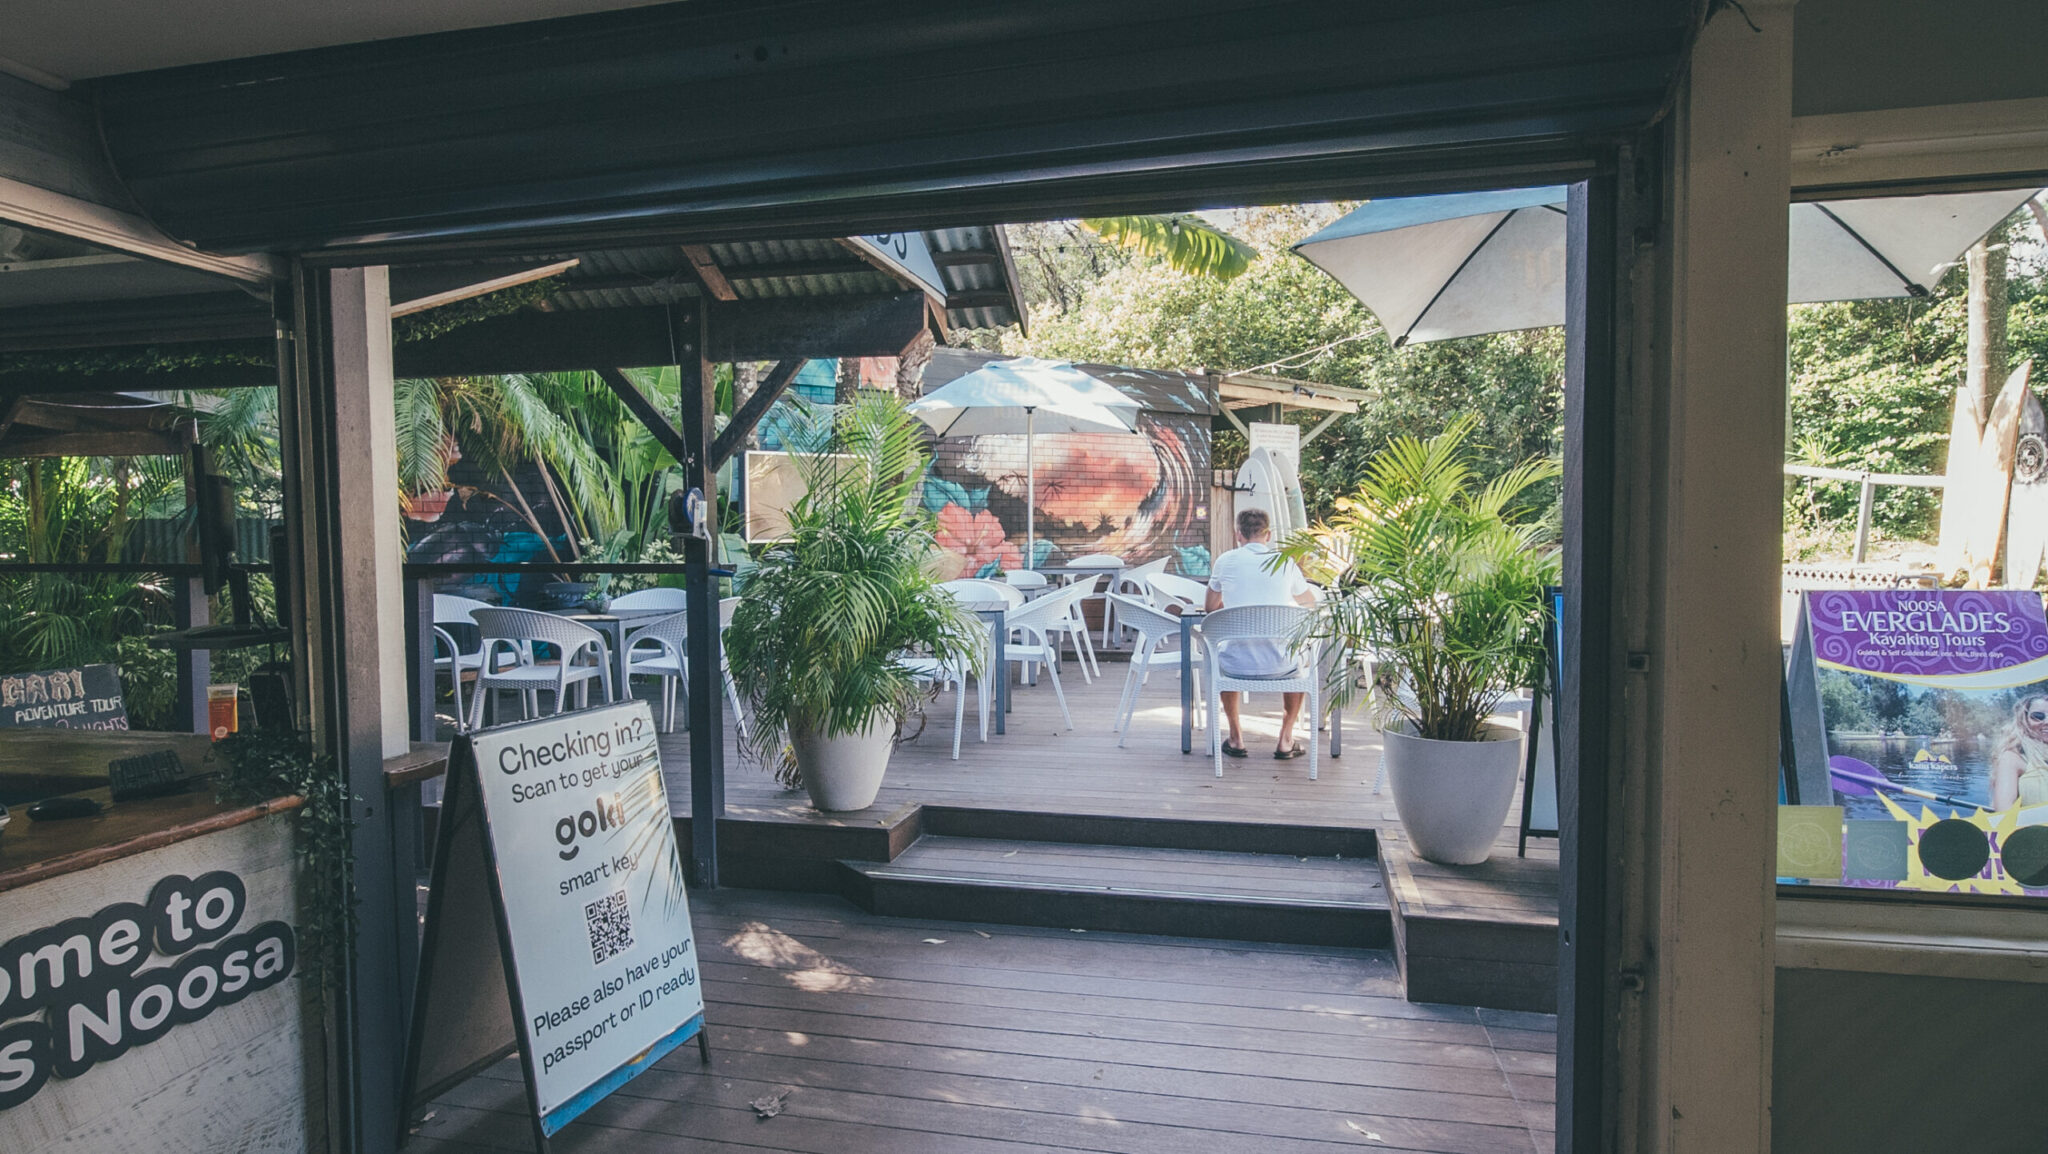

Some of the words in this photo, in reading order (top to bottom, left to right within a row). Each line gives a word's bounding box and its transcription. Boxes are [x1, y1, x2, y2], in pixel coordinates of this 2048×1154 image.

[1841, 611, 2011, 633] EVERGLADES
[1898, 600, 1947, 612] NOOSA
[1869, 632, 1940, 649] Kayaking
[1943, 633, 1986, 647] Tours
[1988, 651, 2004, 659] days
[15, 701, 88, 724] ADVENTURE
[90, 695, 122, 713] TOUR
[498, 731, 612, 775] Checking
[615, 717, 643, 746] in?
[511, 780, 557, 803] Scan
[559, 773, 579, 790] to
[583, 763, 610, 788] get
[612, 753, 644, 779] your
[555, 792, 625, 861] goki
[559, 862, 611, 896] smart
[612, 852, 640, 874] key
[0, 919, 141, 1006] me
[165, 887, 235, 942] to
[67, 937, 285, 1062] Noosa
[533, 997, 591, 1037] Please
[593, 980, 625, 1004] also
[626, 957, 660, 985] have
[661, 938, 692, 968] your
[542, 1012, 619, 1074] passport
[620, 1003, 637, 1022] or
[639, 990, 654, 1011] ID
[656, 967, 696, 1000] ready
